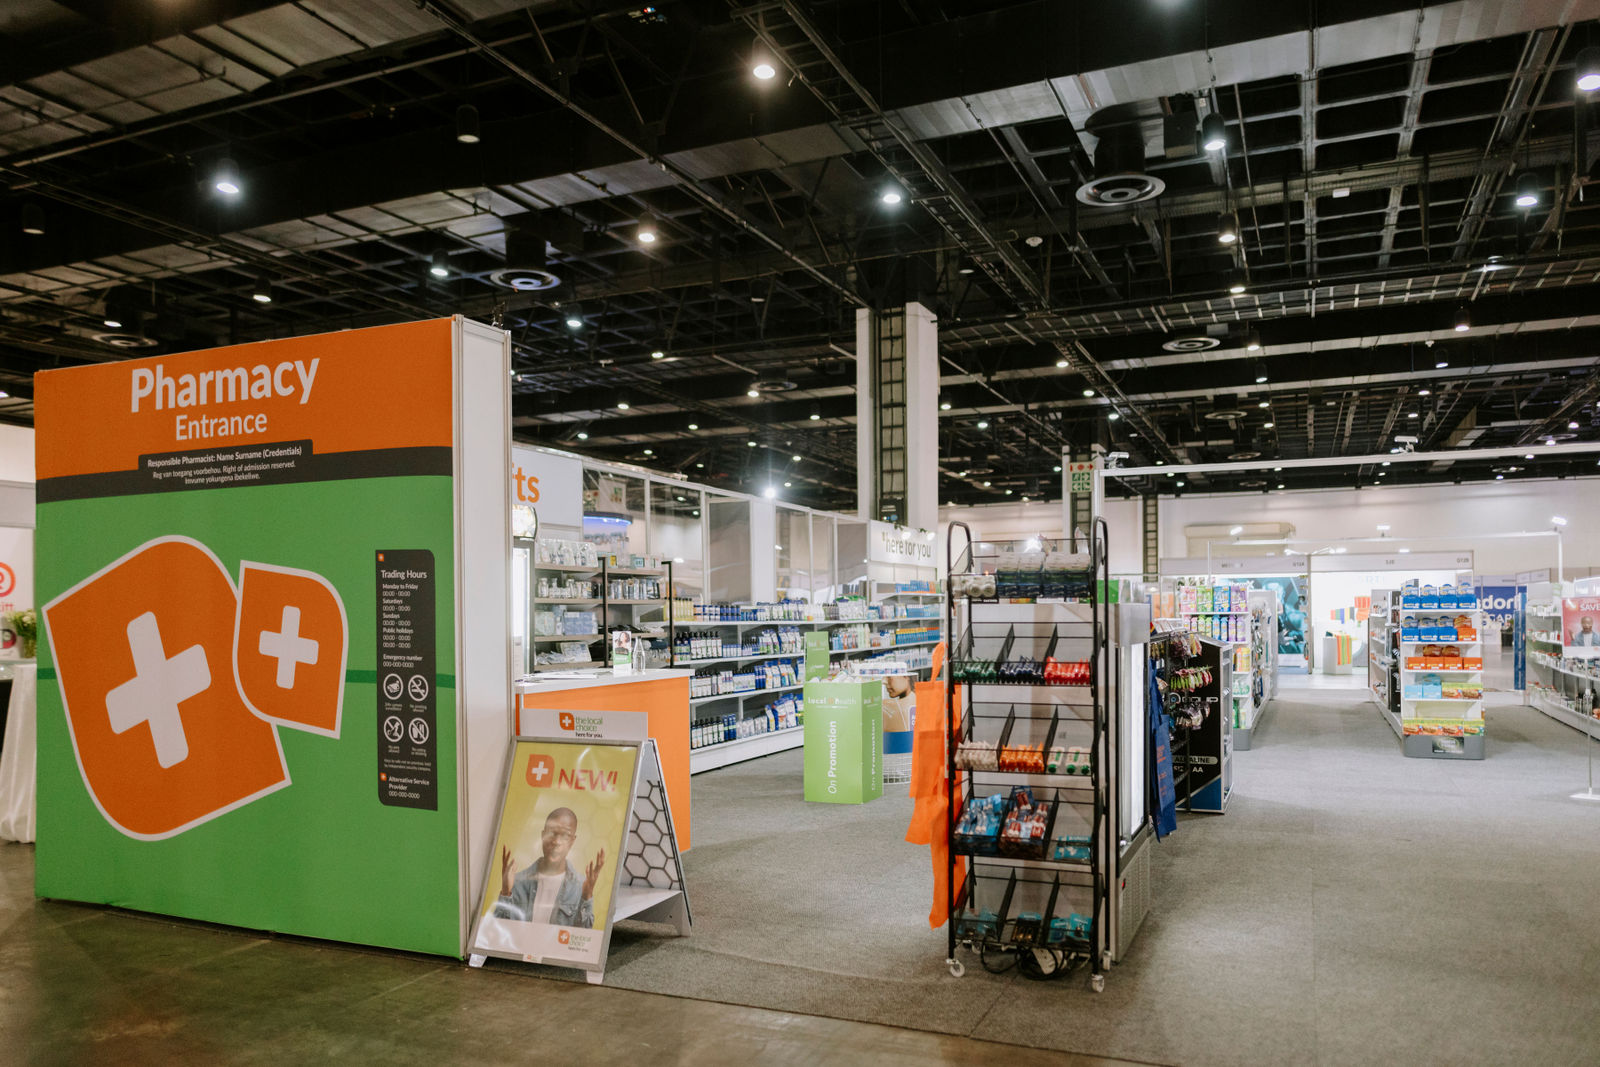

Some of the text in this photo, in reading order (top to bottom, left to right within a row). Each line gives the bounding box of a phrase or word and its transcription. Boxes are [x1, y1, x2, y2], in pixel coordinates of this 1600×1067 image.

[131, 358, 320, 413] Pharmacy
[176, 413, 268, 441] Entrance
[147, 446, 302, 468] Responsible Pharmacist: Name Surname (Credentials)
[222, 465, 236, 474] Right
[237, 464, 244, 472] of
[244, 462, 270, 472] admission
[904, 540, 916, 556] for
[916, 543, 932, 560] you
[381, 570, 428, 580] Trading Hours
[828, 720, 837, 794] On Promotion
[558, 768, 618, 792] NEW!
